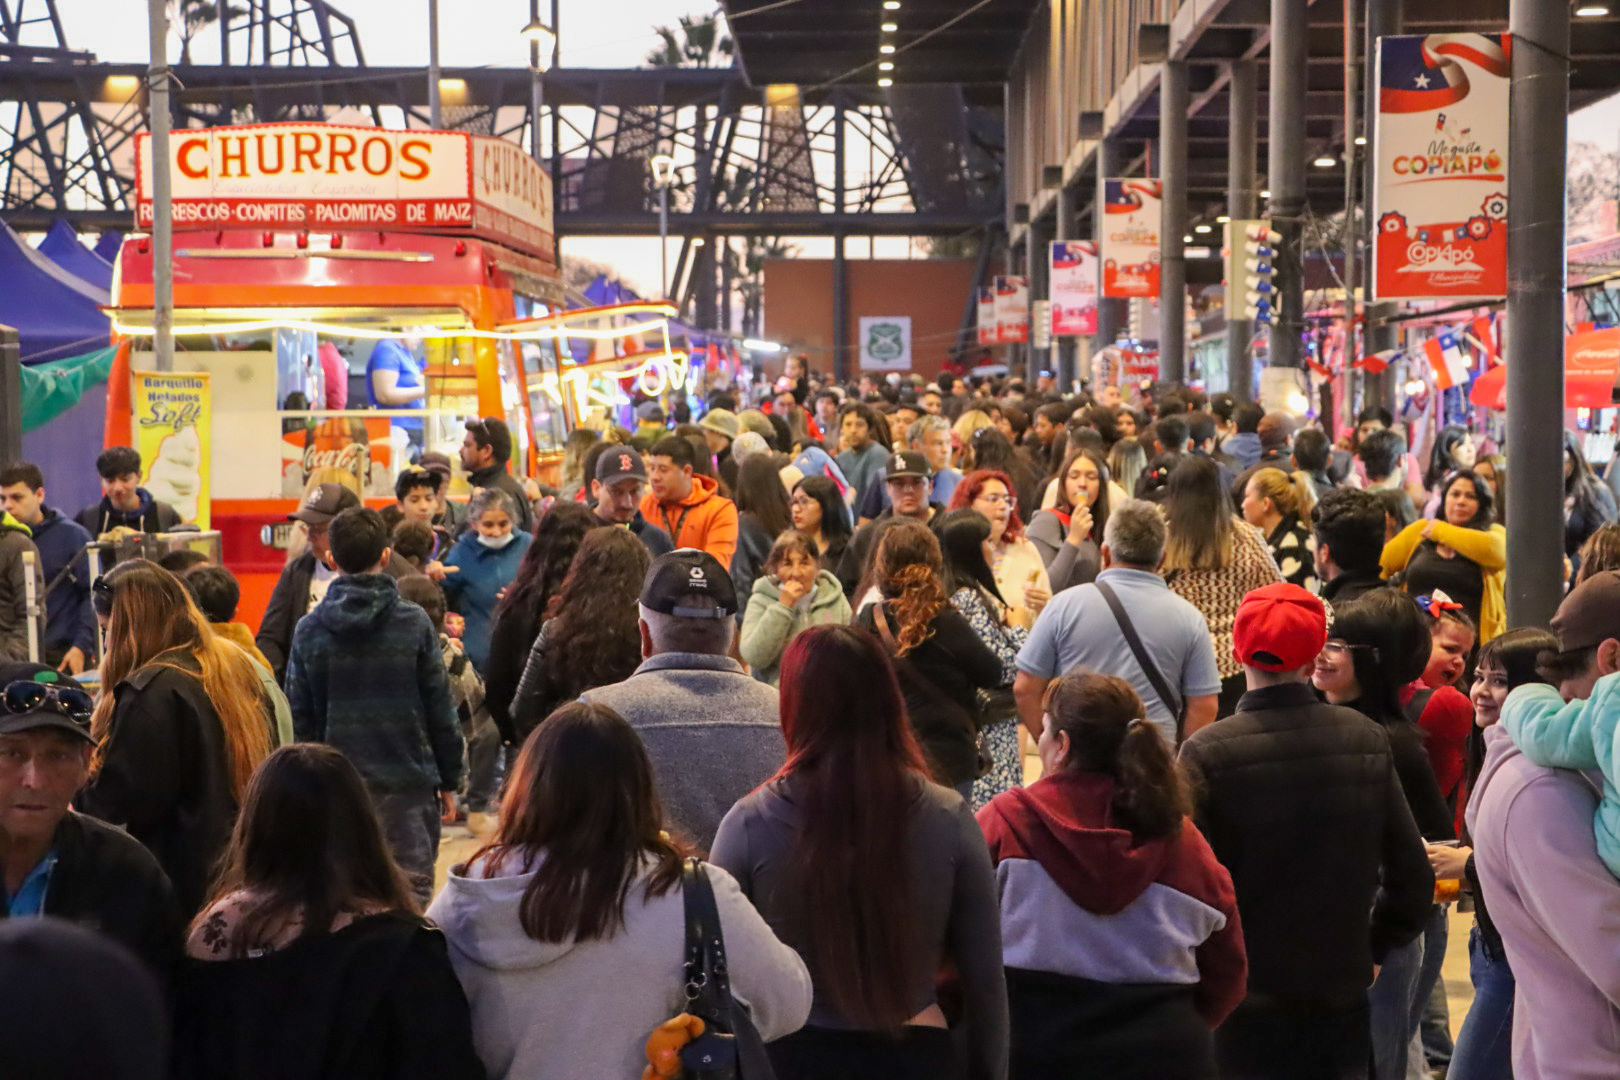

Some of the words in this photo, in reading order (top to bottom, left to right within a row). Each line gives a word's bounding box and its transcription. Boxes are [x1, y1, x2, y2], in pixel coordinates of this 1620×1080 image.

[176, 132, 433, 180] CHURROS
[1449, 141, 1482, 162] gusta
[483, 143, 547, 219] CHURROS
[140, 202, 230, 221] RRESCOS
[235, 202, 306, 222] CONFITES
[315, 203, 397, 222] PALOMITAS
[406, 203, 427, 222] DE
[434, 202, 472, 221] MAIZ
[144, 376, 203, 390] Barquillo
[148, 391, 200, 402] Helados
[139, 401, 202, 431] Soft
[619, 454, 633, 471] B
